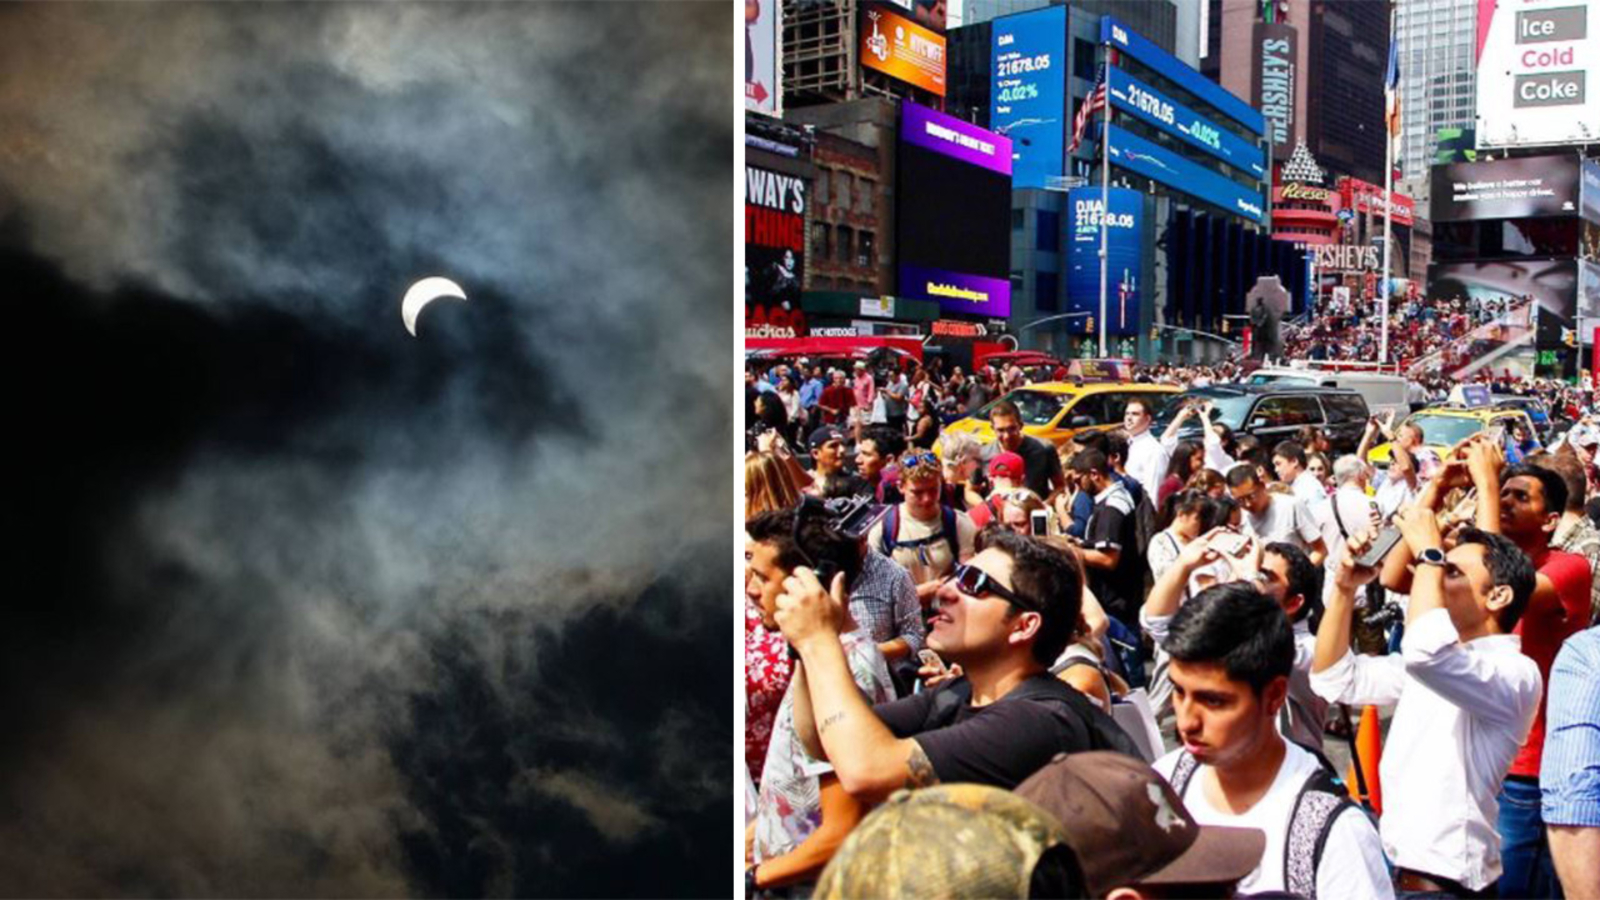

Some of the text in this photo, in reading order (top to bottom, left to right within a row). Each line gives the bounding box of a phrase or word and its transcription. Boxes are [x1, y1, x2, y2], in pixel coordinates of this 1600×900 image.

[1522, 18, 1555, 37] Ice
[1521, 47, 1574, 68] Cold
[1520, 79, 1579, 100] Coke
[745, 167, 804, 214] WAY'S
